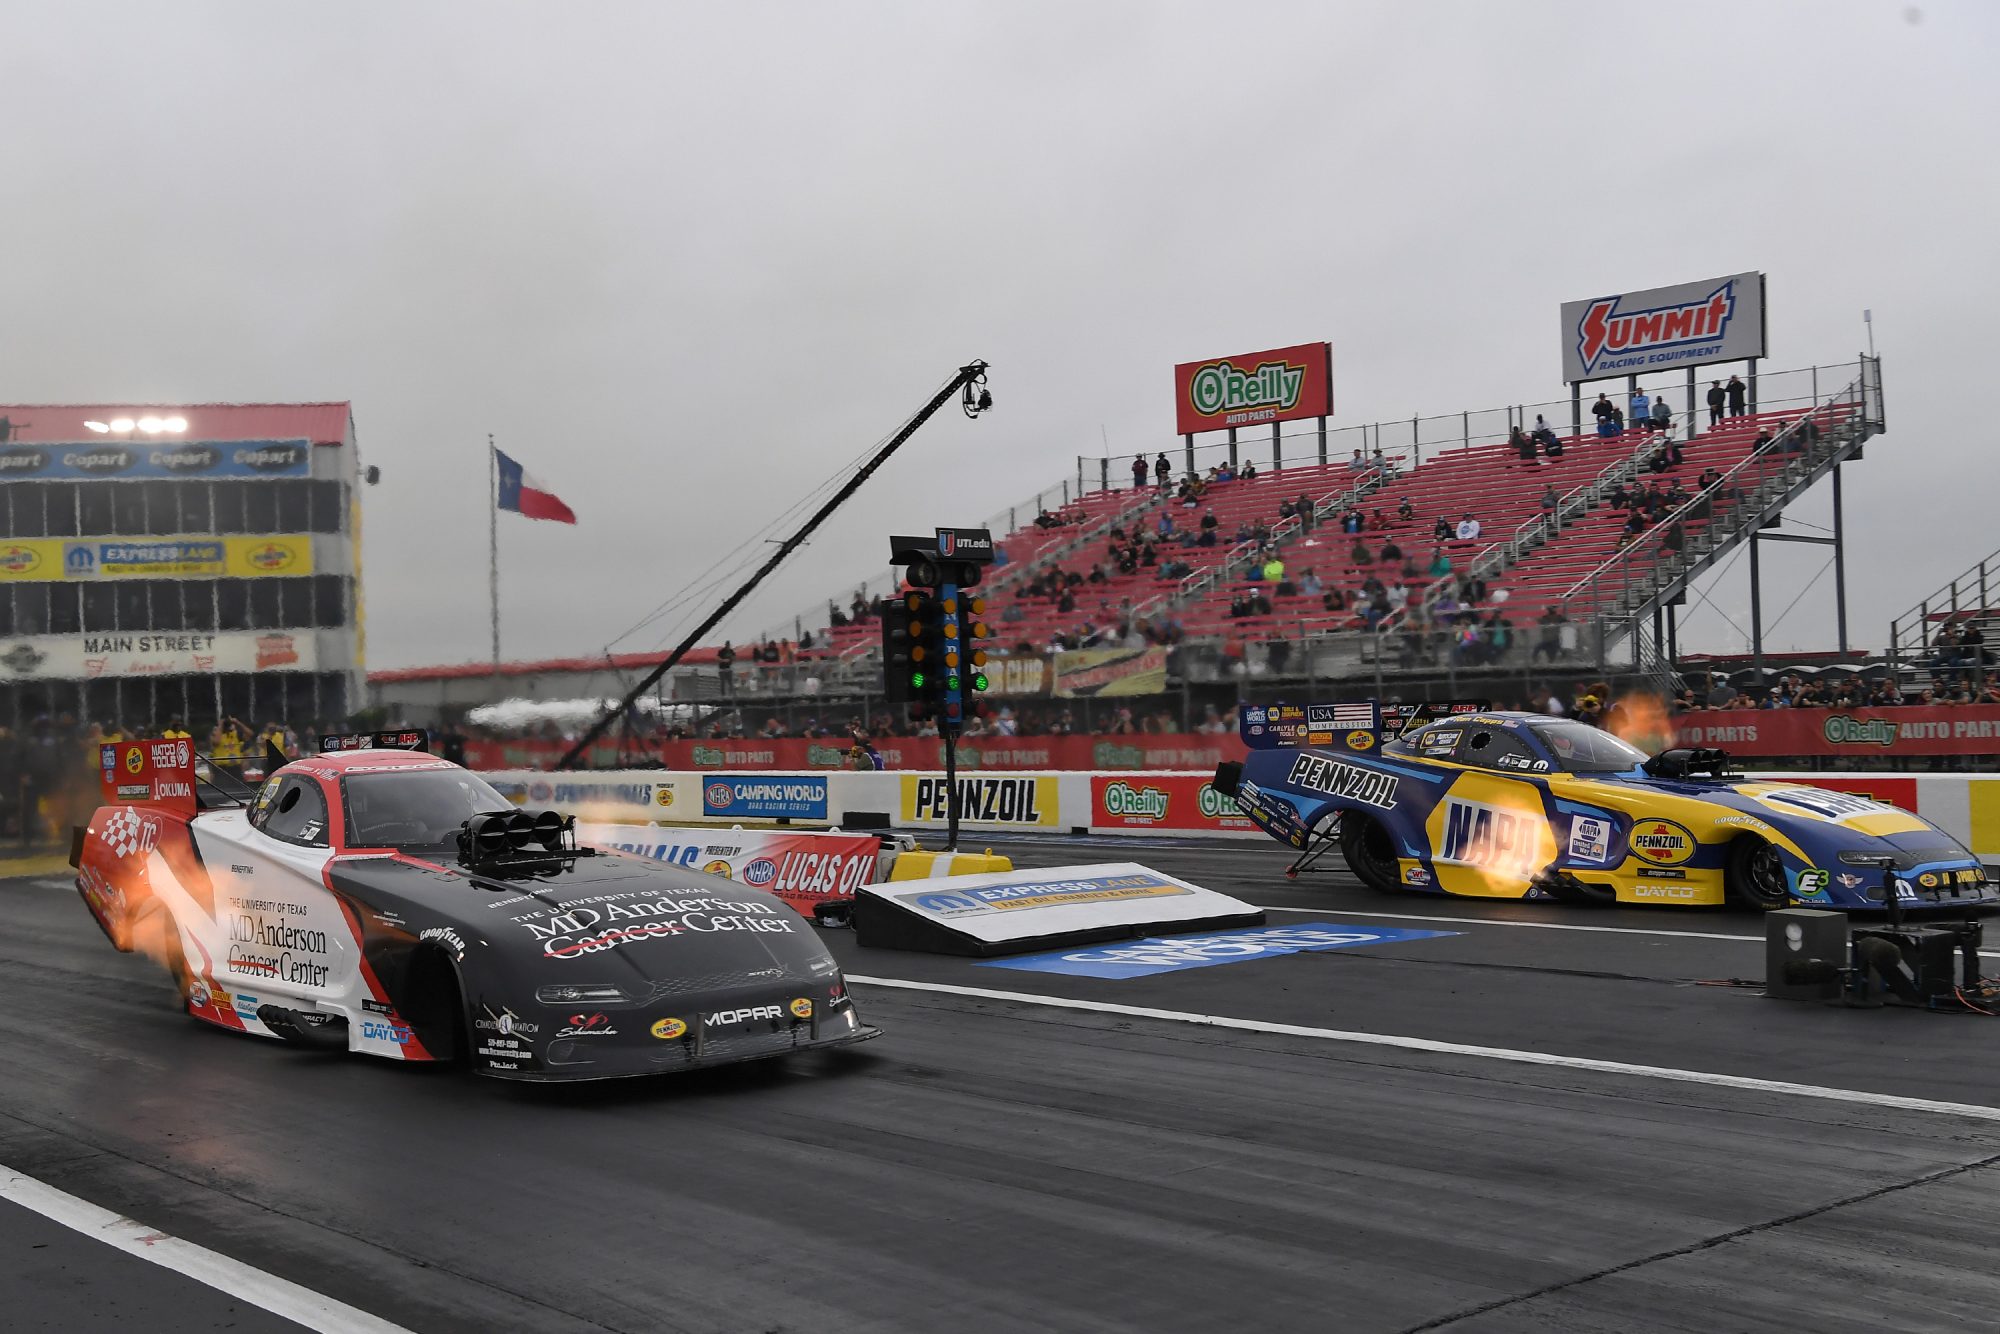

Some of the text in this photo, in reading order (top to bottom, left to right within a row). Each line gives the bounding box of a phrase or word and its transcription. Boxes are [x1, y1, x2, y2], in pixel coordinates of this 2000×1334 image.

[1599, 345, 1723, 370] RACING EQUIPMENT
[1195, 366, 1300, 410] O'Reilly
[1226, 409, 1276, 425] AUTO PARTS
[63, 452, 127, 468] Copart
[149, 451, 211, 468] Copart
[233, 449, 296, 466] Copart
[956, 538, 990, 549] UTI.edu
[84, 636, 216, 653] MAIN STREET
[1311, 709, 1333, 720] USA
[1451, 704, 1477, 713] ARP
[1309, 721, 1373, 729] COMPRESSION
[1473, 717, 1505, 725] Capps
[1706, 725, 1758, 742] PARTS
[1826, 716, 1896, 745] O'Reilly
[1901, 720, 1950, 739] AUTO
[151, 744, 176, 756] MATCO
[151, 756, 177, 768] TOOLS
[160, 782, 191, 797] OKUMA
[1287, 753, 1399, 810] PENNZOIL
[708, 788, 731, 804] NHRA
[734, 784, 825, 802] CAMPING WORLD
[1107, 784, 1167, 817] O'Reilly
[789, 803, 810, 811] SERIES
[1581, 824, 1599, 837] NAPA
[1713, 815, 1769, 831] GOODYEAR
[139, 821, 157, 854] TC
[1443, 803, 1535, 876] NAPA
[1635, 835, 1685, 849] PENNZOIL
[705, 845, 734, 856] PRESENTED
[734, 846, 742, 856] BY
[746, 862, 775, 883] NHRA
[774, 851, 875, 895] LUCAS OIL
[1798, 868, 1829, 893] E3
[976, 876, 1154, 900] EXPRESS LANE
[1635, 885, 1695, 899] DAYCO
[229, 897, 308, 916] THE UNIVERSITY OF TEXAS
[510, 887, 712, 923] THE UNIVERSITY OF TEXAS
[1001, 897, 1031, 909] FAST
[521, 896, 778, 941] MD Anderson
[229, 913, 327, 954] MD Anderson
[420, 927, 466, 951] GOODYEAR
[543, 912, 797, 960] Cancer Center
[228, 944, 329, 988] Cancer Center
[302, 1014, 325, 1023] MPACT
[705, 1005, 784, 1027] MOPAR
[364, 1021, 411, 1045] DAYCO
[656, 1023, 682, 1035] PENNZOIL
